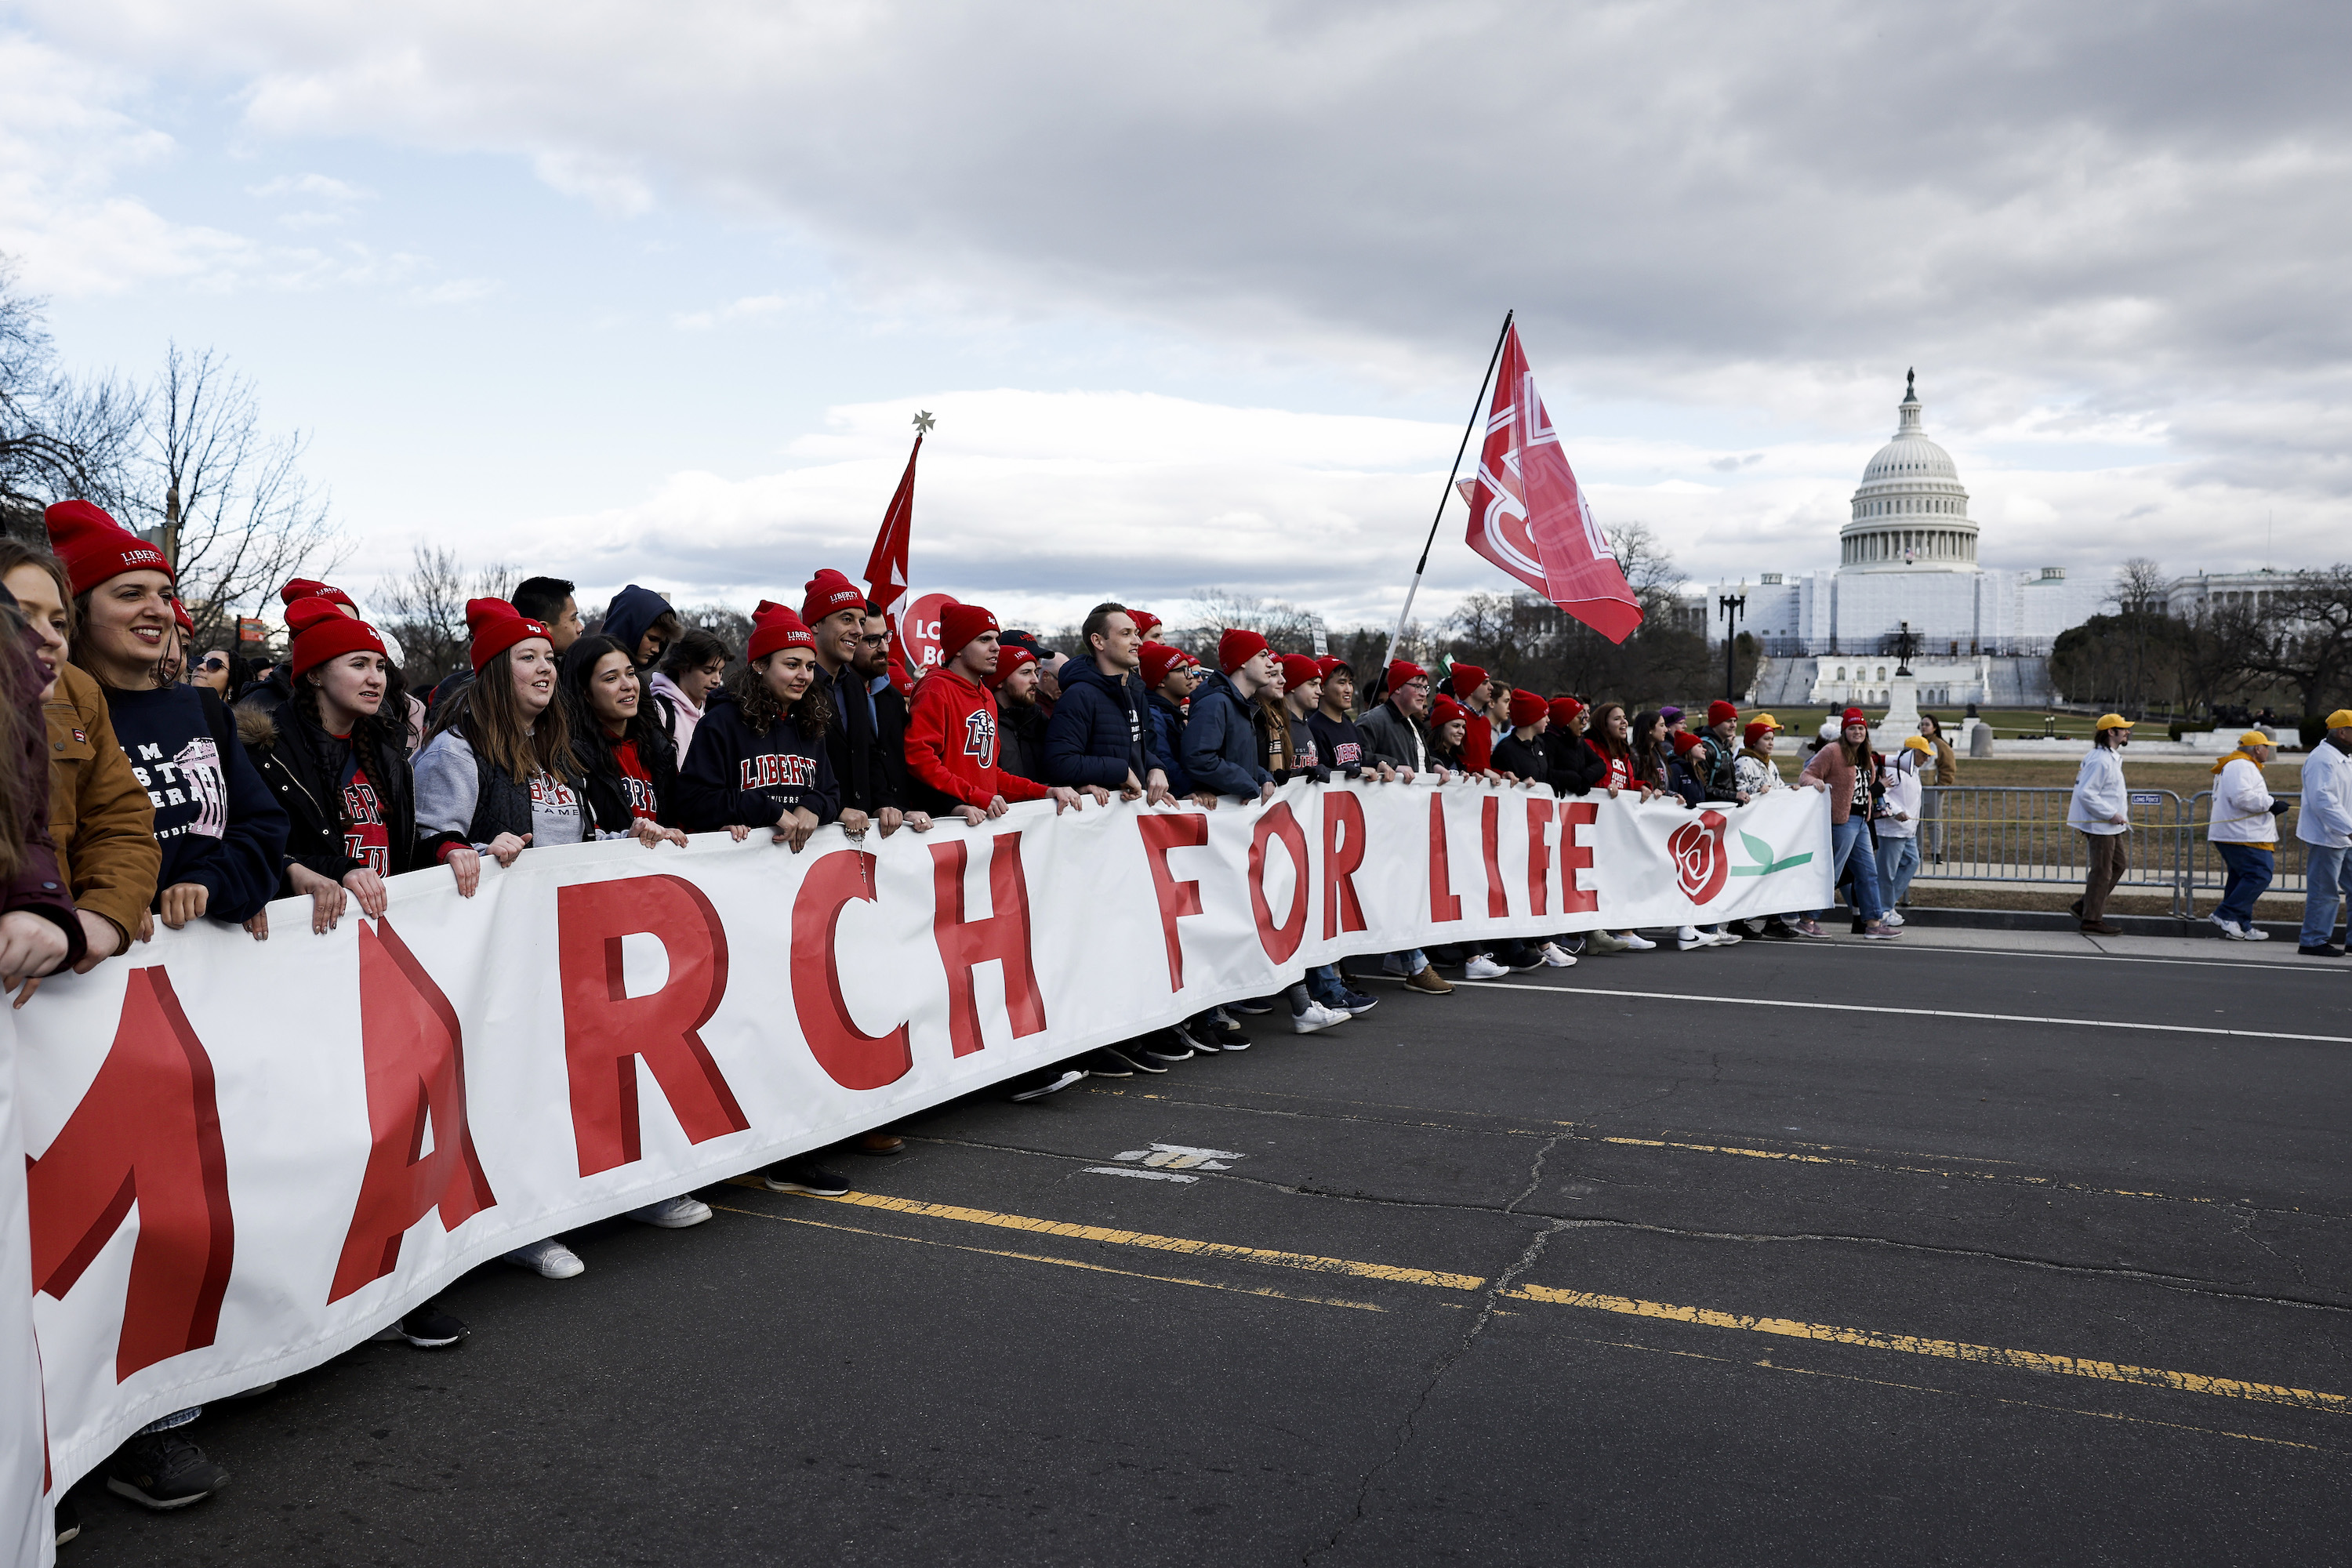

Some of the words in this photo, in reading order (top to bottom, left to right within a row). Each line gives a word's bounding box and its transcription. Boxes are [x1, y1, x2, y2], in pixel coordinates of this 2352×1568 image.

[830, 591, 858, 601] LIBERTY
[366, 627, 379, 640] LU
[526, 624, 541, 633] LU
[964, 715, 996, 768] LU
[1136, 790, 1367, 993] FOR
[1429, 792, 1599, 923] LIFE
